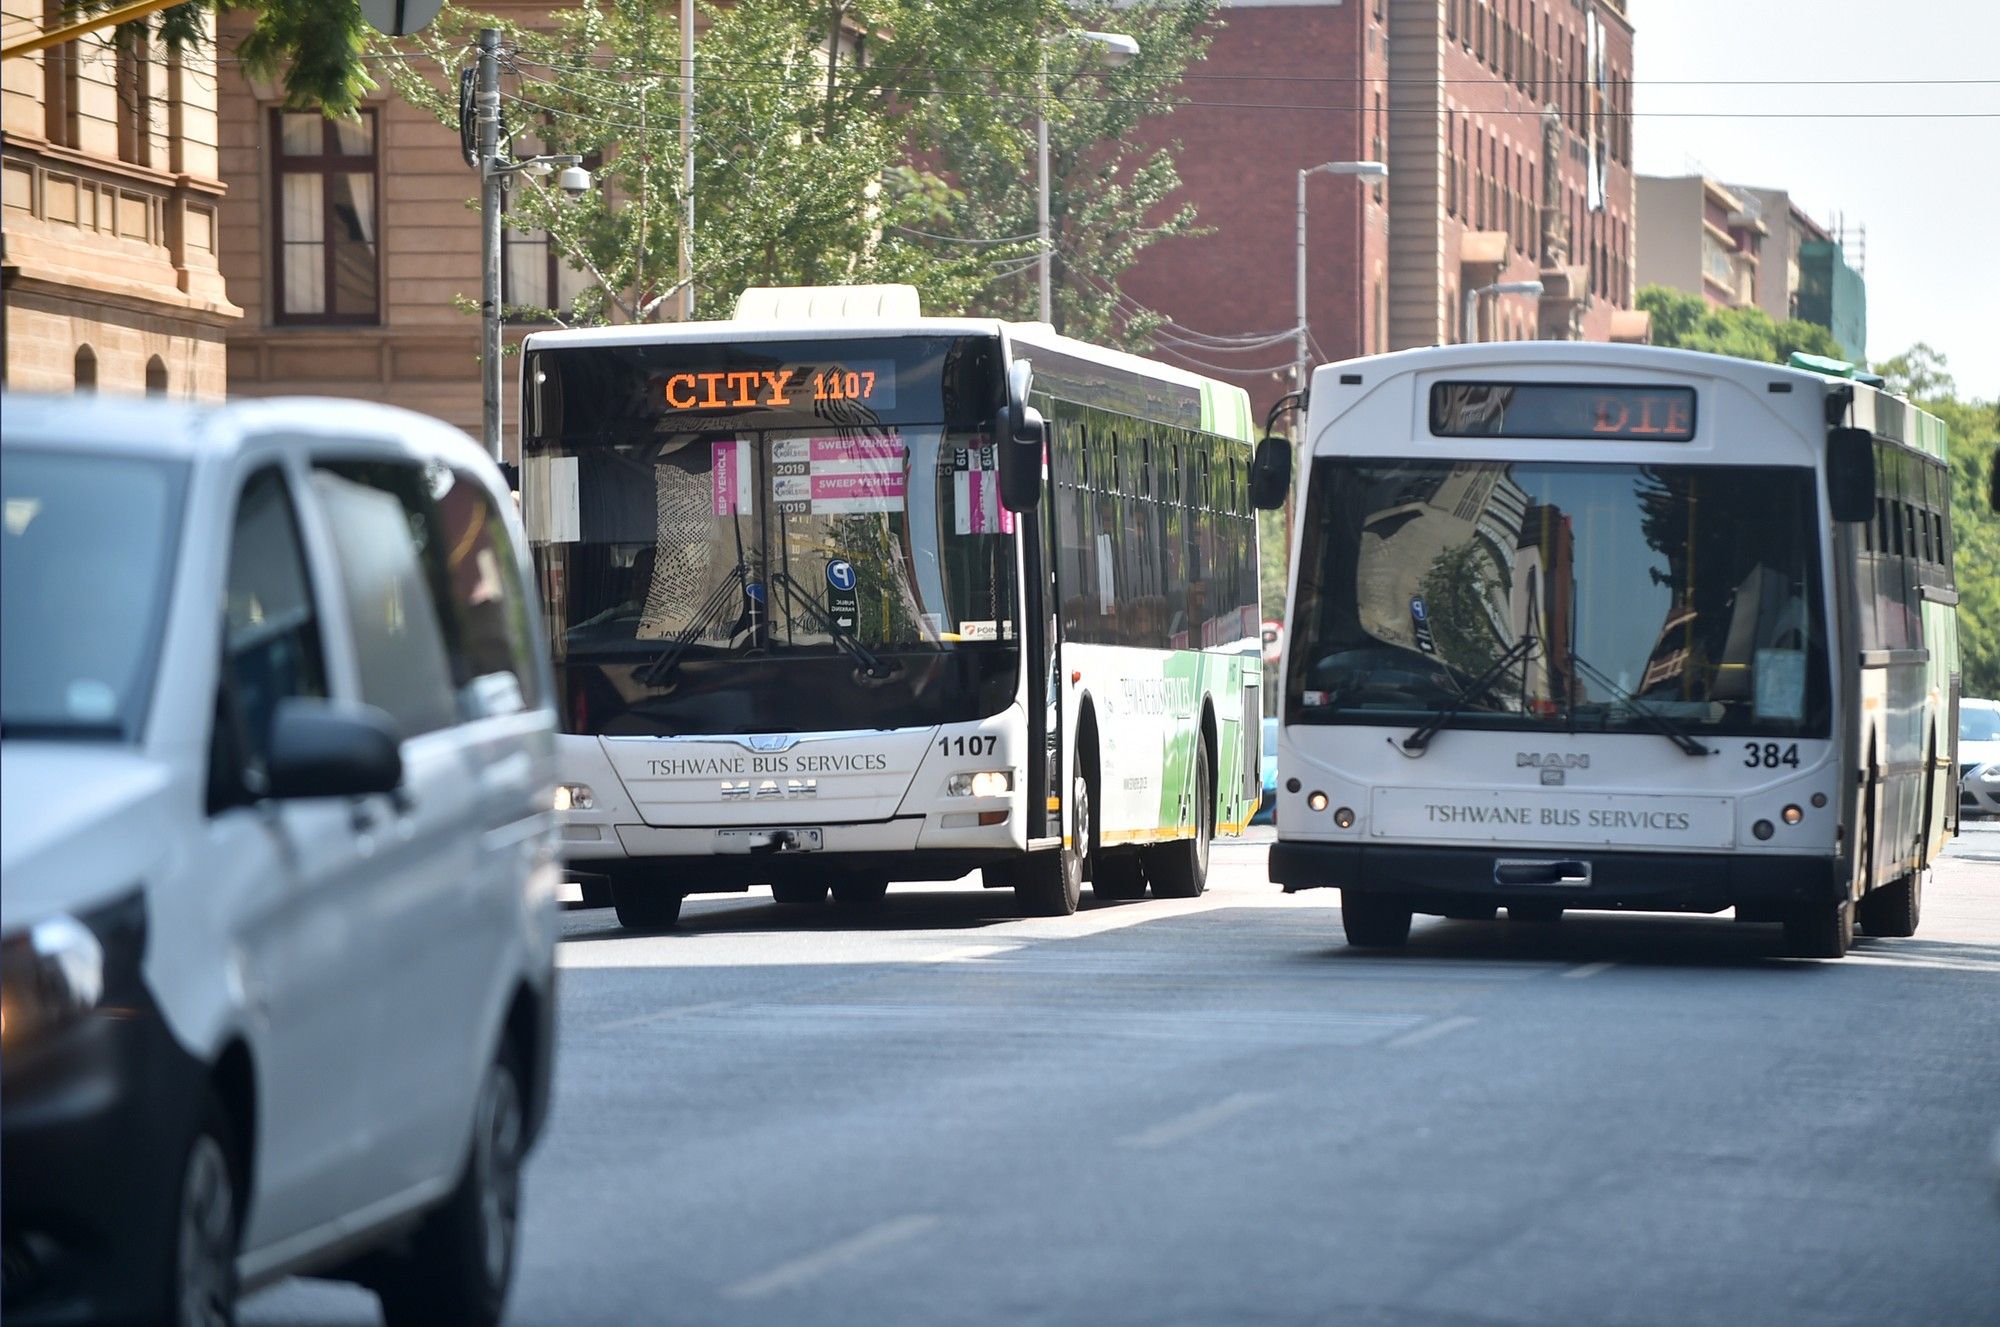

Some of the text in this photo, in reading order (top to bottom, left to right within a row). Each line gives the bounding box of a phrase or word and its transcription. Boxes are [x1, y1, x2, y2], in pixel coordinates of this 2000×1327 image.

[666, 371, 875, 408] CITY 1107
[818, 438, 903, 450] SWEEP VEHICLE
[982, 447, 992, 467] 019
[777, 464, 805, 475] 2019
[718, 448, 727, 516] EEP VEHICLE
[819, 477, 903, 489] SWEEP VEHICLE
[938, 736, 997, 757] 1107
[1743, 742, 1800, 769] 384
[647, 753, 888, 775] TSHWANE BUS SERVICES
[1516, 752, 1591, 769] MAN
[721, 778, 818, 801] MAN
[1425, 804, 1690, 831] TSHWANE BUS SERVICES
